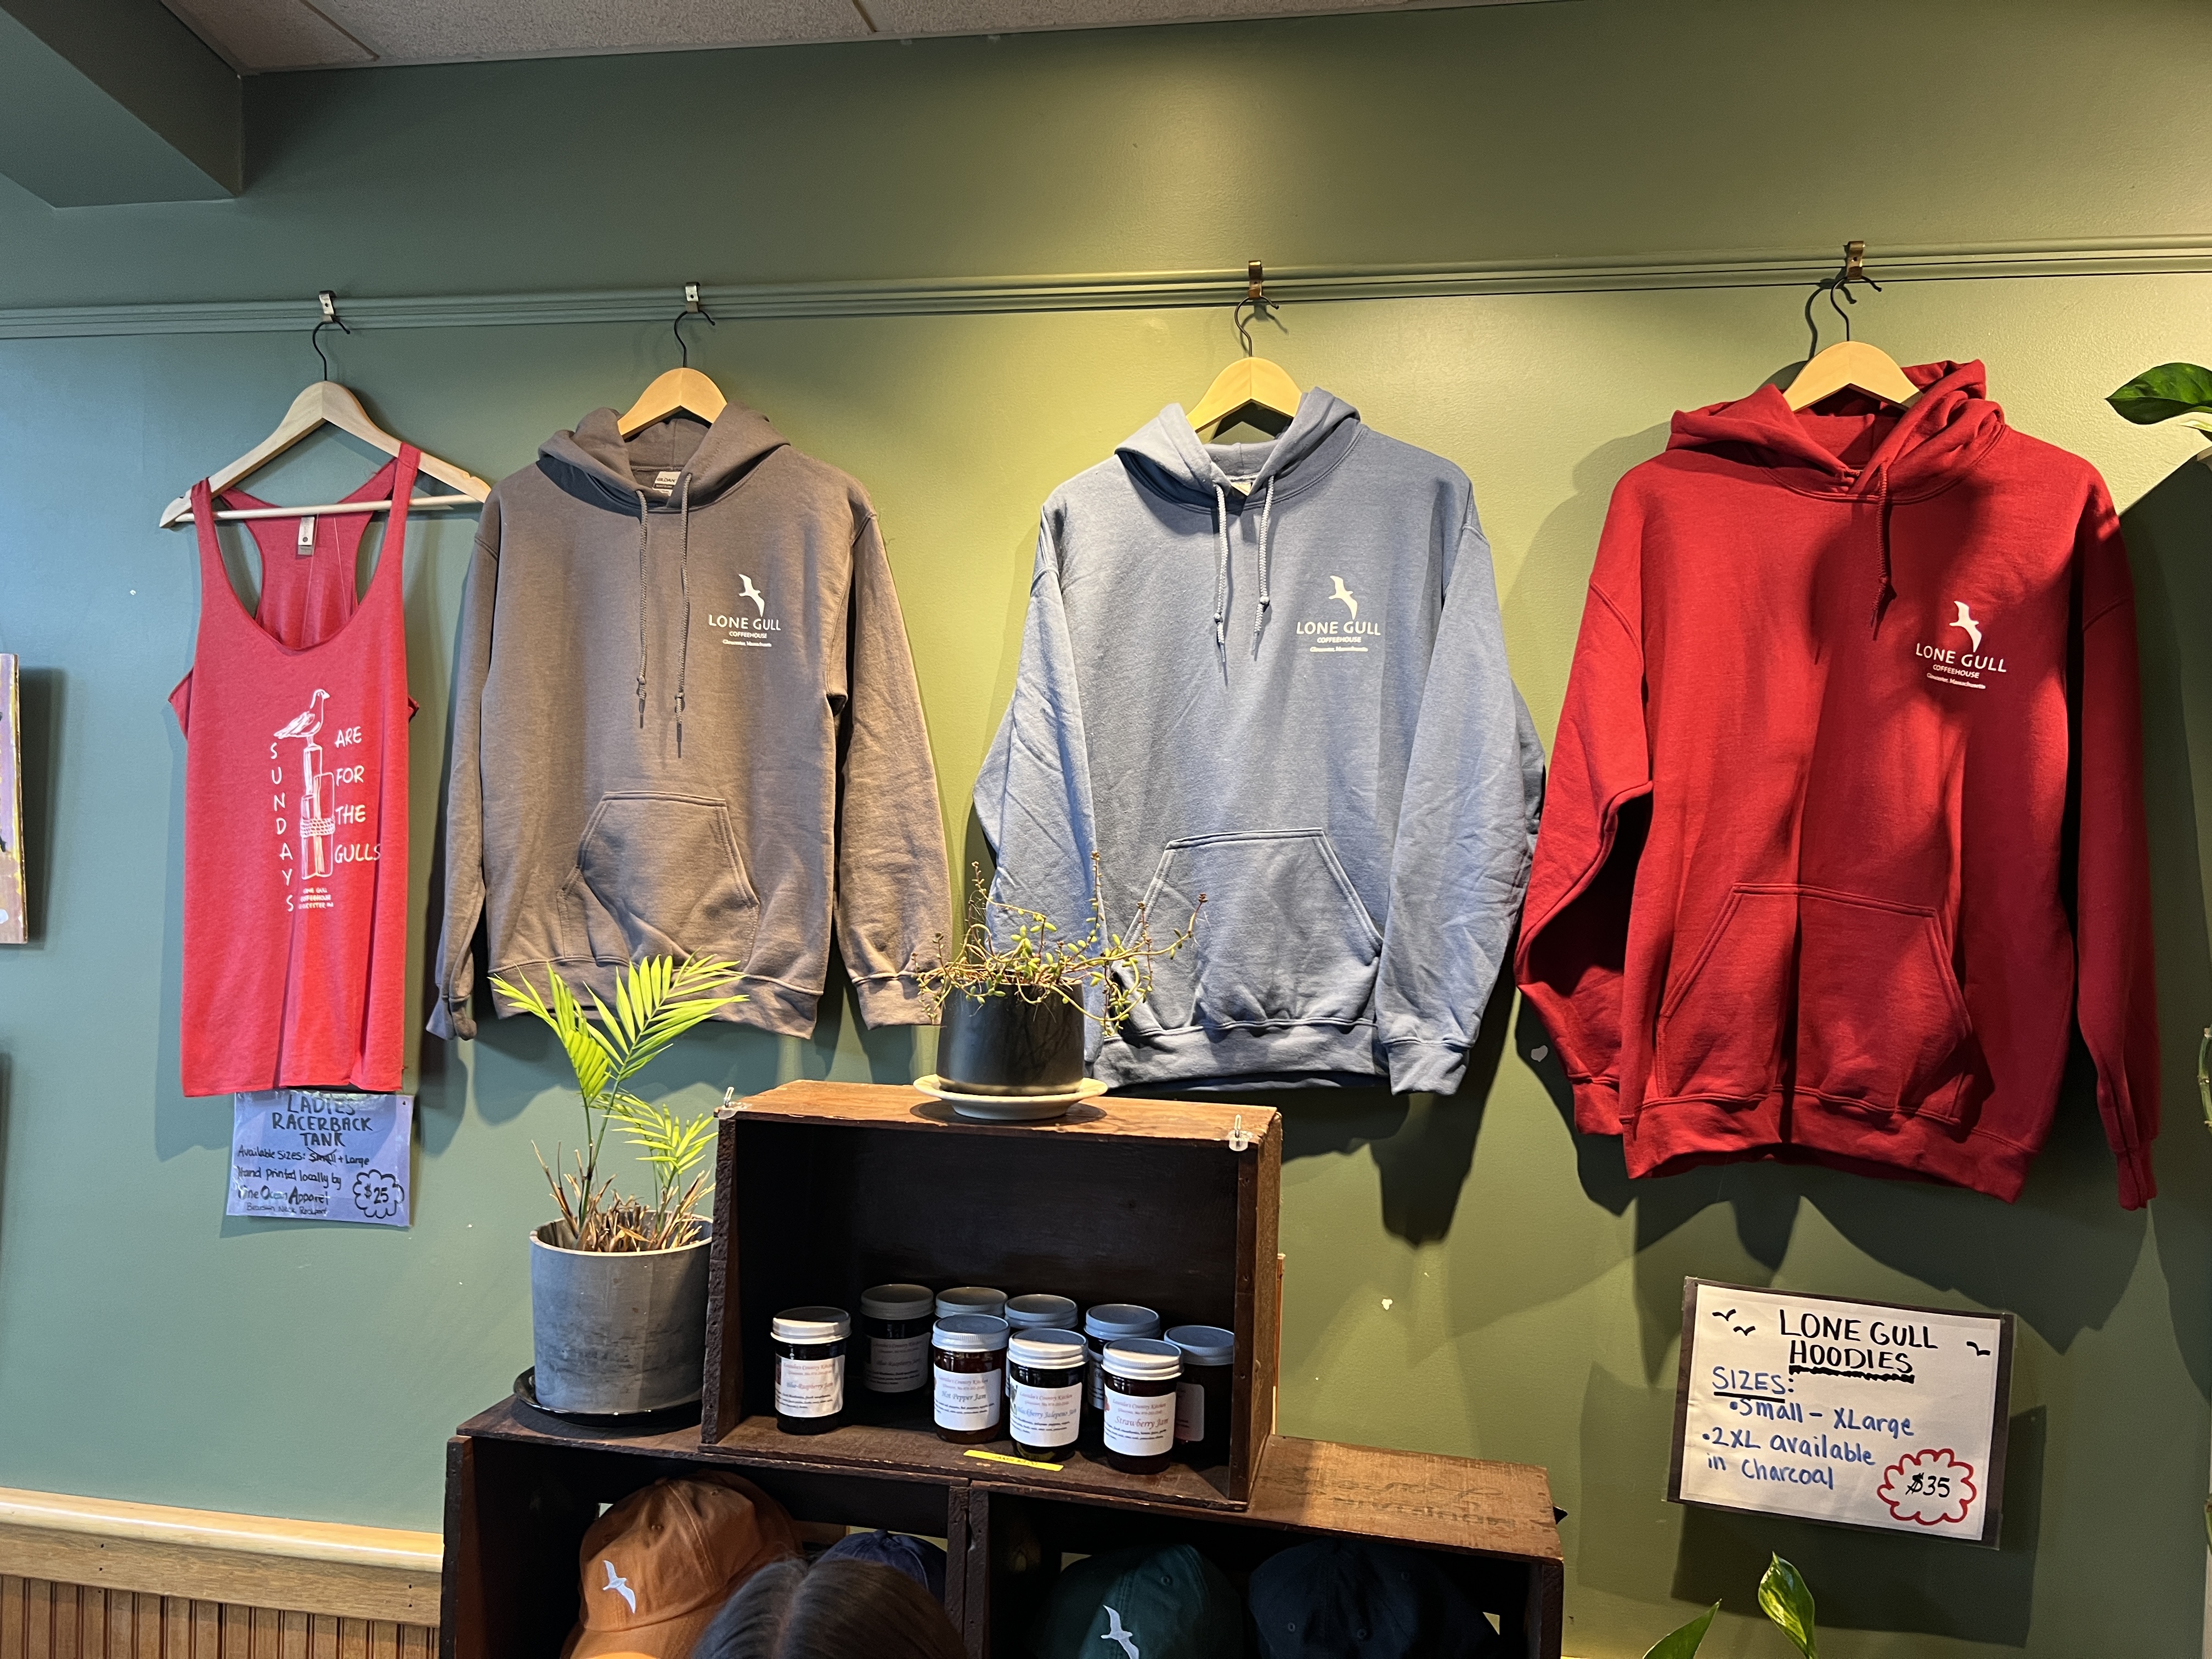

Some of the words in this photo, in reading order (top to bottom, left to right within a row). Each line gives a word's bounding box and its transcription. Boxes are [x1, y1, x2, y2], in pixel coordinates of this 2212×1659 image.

[709, 614, 748, 629] LONE
[753, 618, 781, 631] GULL
[1296, 621, 1339, 635] LONE
[1344, 621, 1381, 636] GULL
[729, 631, 768, 639] COFFEEHOUSE
[1916, 642, 1956, 664] LONE
[1961, 654, 2007, 673] GULL
[1932, 664, 1980, 679] COFFEEHOUSE
[335, 725, 363, 748] ARE
[335, 765, 365, 787] FOR
[335, 804, 366, 826] THE
[334, 843, 381, 865] GULLS
[287, 1094, 356, 1116] LADIES
[272, 1112, 373, 1132] RACERBACK
[300, 1132, 346, 1148] TANK
[238, 1144, 275, 1159] Available
[345, 1154, 370, 1168] Large
[237, 1165, 261, 1178] Hand
[266, 1168, 297, 1181] printed
[299, 1169, 329, 1189] locally
[331, 1172, 342, 1190] by
[364, 1183, 389, 1205] $25
[1780, 1308, 1861, 1342] LONE
[1870, 1322, 1939, 1350] GULL
[1788, 1339, 1913, 1374] HOODIES
[1712, 1365, 1795, 1395] SIZES:
[952, 1393, 973, 1402] Pepper
[1114, 1415, 1155, 1430] Strawberry
[1154, 1417, 1169, 1427] Jam
[1833, 1407, 1915, 1440] XLarge
[1769, 1432, 1876, 1466] available
[1707, 1452, 1727, 1471] in
[1905, 1472, 1950, 1498] $35
